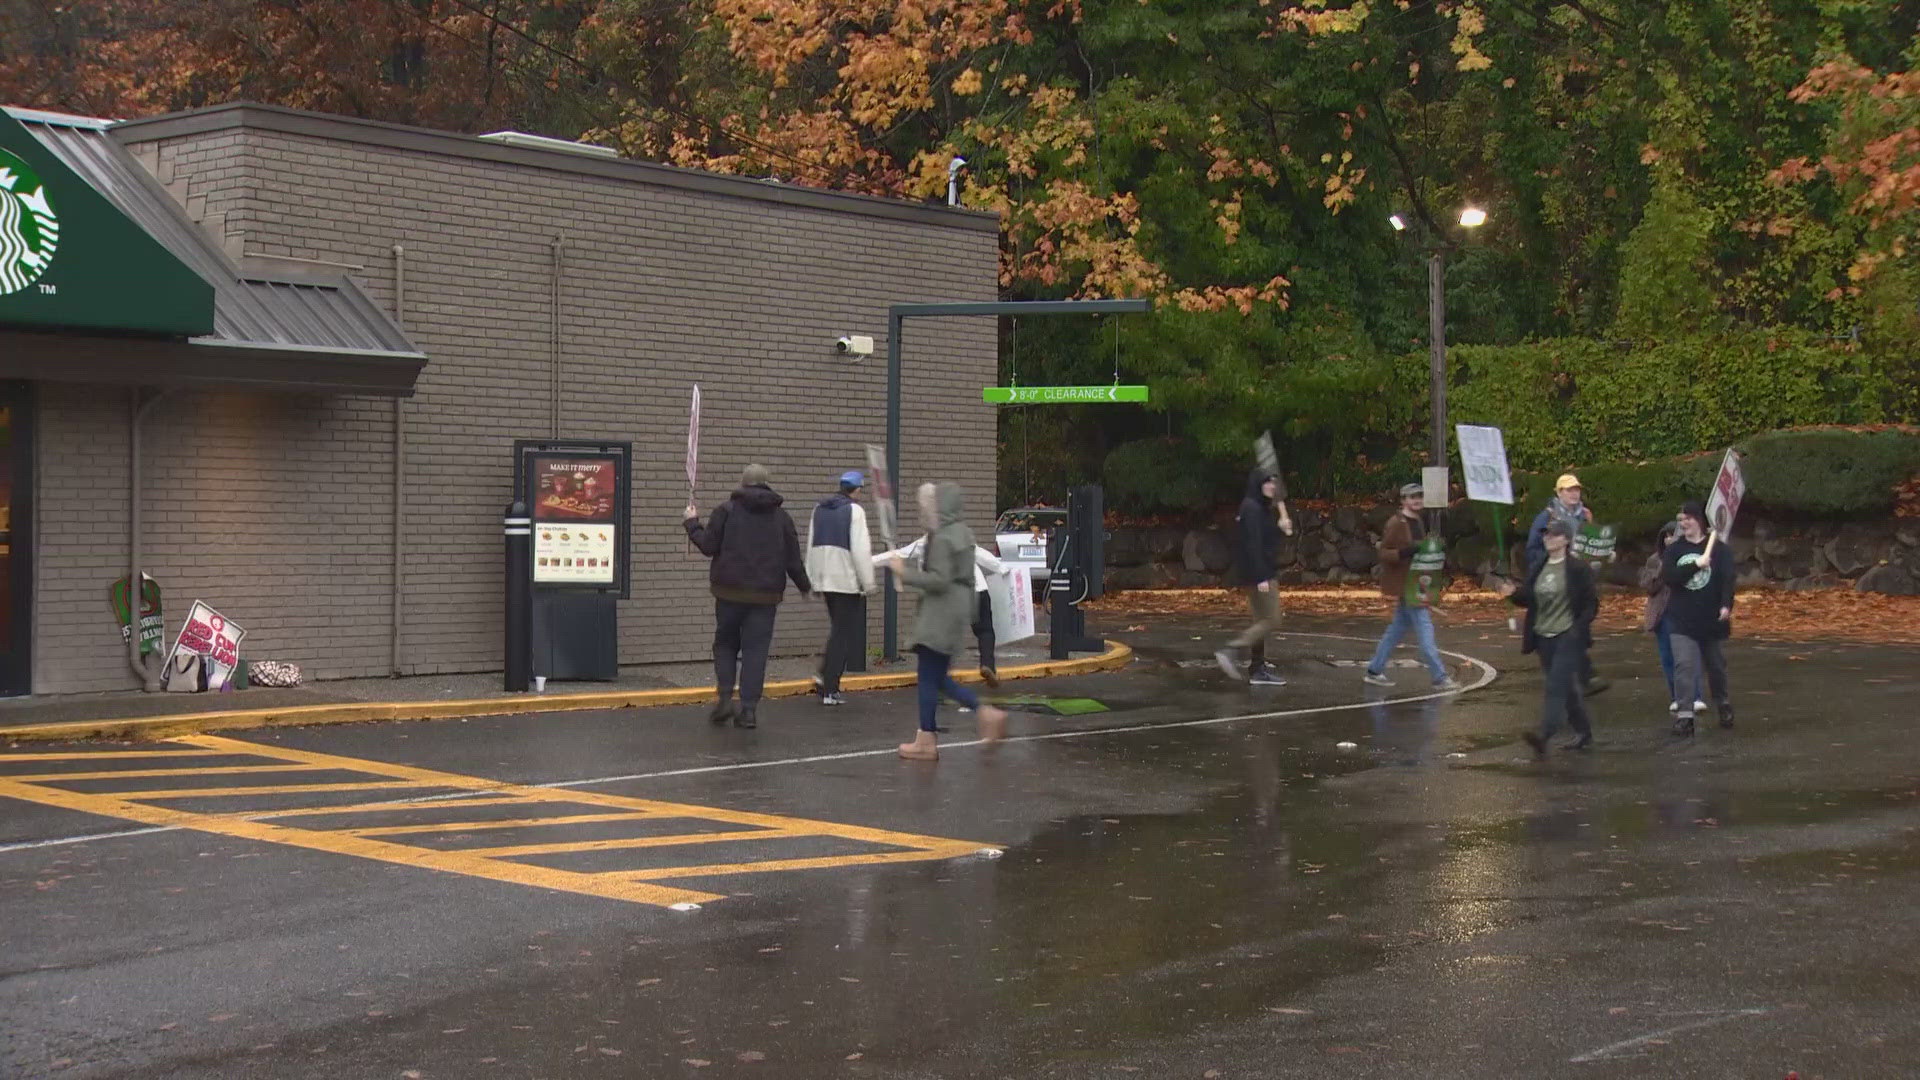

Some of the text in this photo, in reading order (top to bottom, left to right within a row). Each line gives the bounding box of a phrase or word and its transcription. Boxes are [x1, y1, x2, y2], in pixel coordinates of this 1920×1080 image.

[38, 284, 56, 295] TM
[1044, 388, 1105, 400] CLEARANCE
[550, 463, 601, 473] MAKE IT merry
[187, 618, 213, 640] RED
